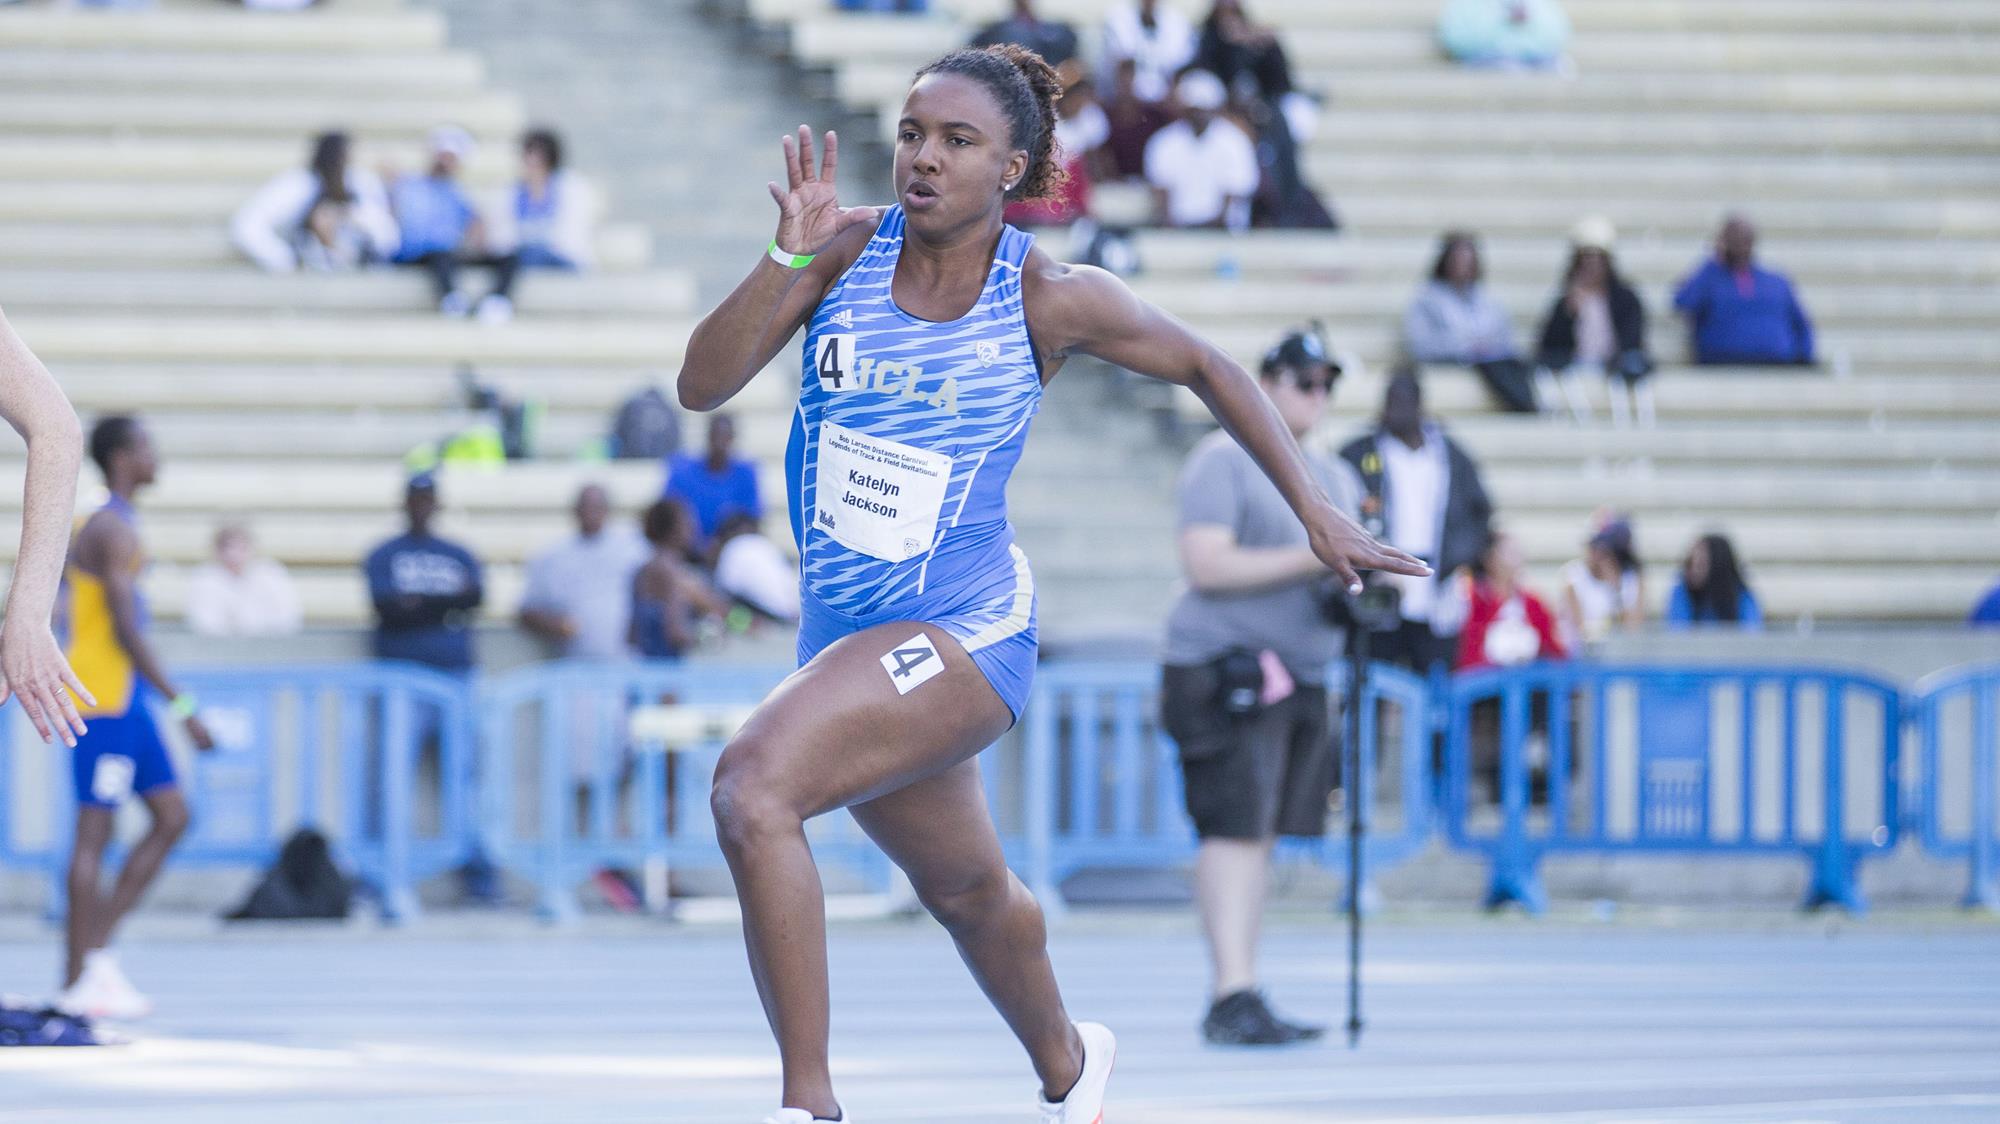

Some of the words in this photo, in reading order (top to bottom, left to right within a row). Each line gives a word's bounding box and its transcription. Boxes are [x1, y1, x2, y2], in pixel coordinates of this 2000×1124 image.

[820, 337, 843, 388] 4
[829, 438, 851, 452] Legends
[859, 450, 875, 461] Track
[884, 457, 900, 468] Field
[901, 462, 938, 477] Invitational
[839, 434, 850, 444] Bob
[851, 439, 871, 451] Larsen
[872, 446, 900, 459] Distance
[901, 454, 929, 466] Carnival
[849, 469, 900, 496] Katelyn
[842, 490, 897, 518] Jackson
[892, 647, 934, 678] 4
